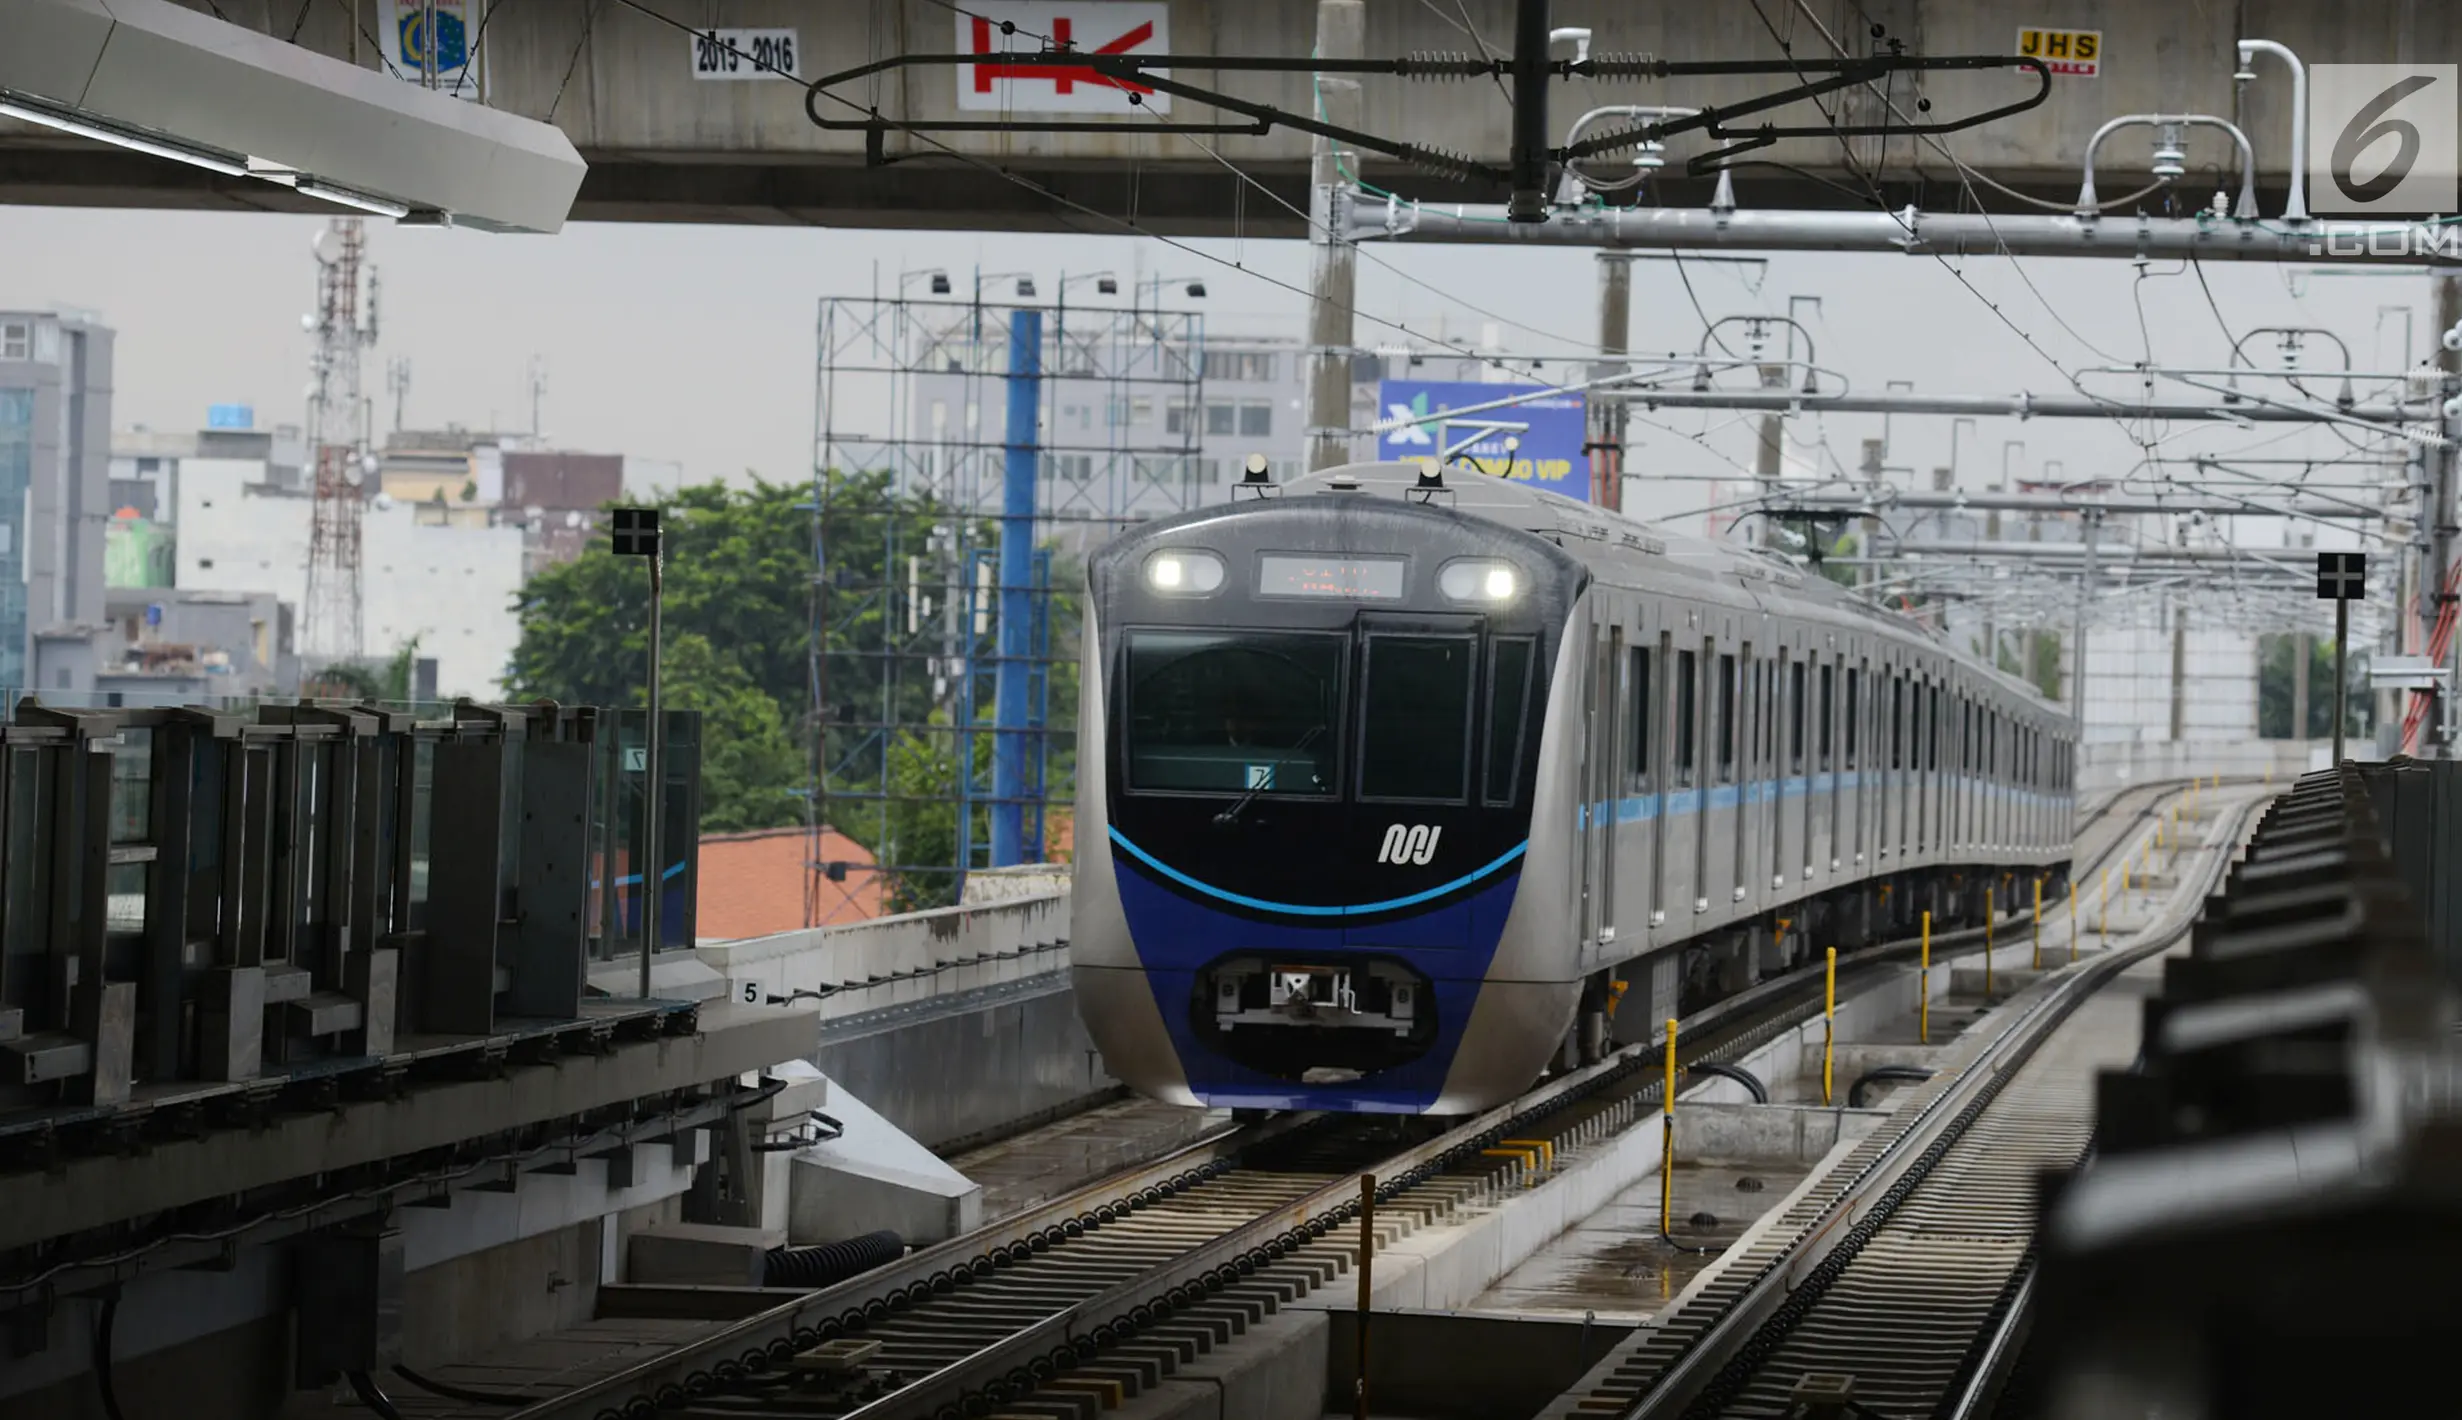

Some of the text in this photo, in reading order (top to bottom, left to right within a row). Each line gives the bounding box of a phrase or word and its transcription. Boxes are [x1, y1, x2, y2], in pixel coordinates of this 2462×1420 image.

[697, 37, 738, 73] 2015
[753, 35, 793, 73] 2016
[2023, 31, 2095, 57] JHS
[1537, 458, 1572, 481] VIP
[744, 982, 757, 1003] 5
